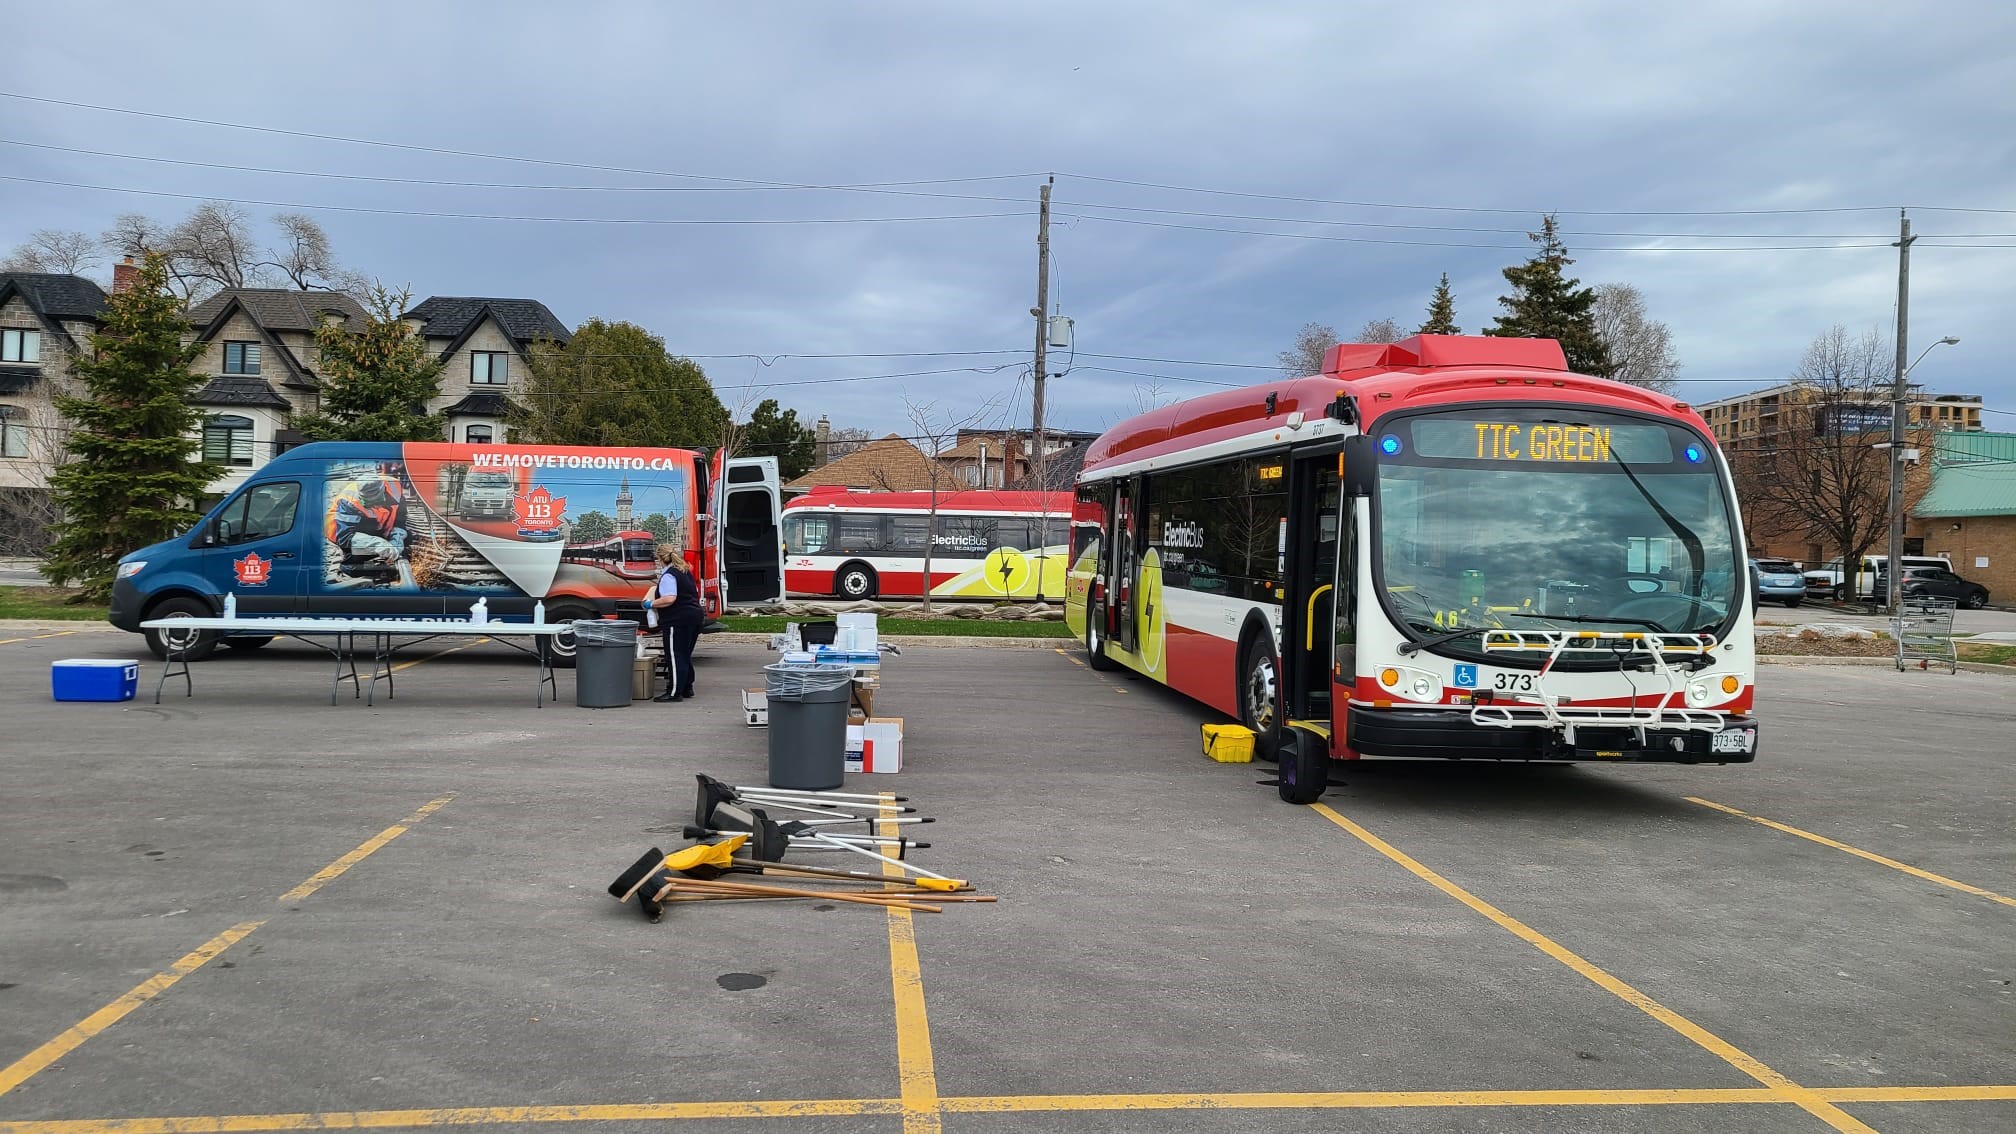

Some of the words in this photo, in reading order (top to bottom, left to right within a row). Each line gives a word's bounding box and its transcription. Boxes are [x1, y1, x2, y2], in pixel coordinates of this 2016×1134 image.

[1474, 424, 1521, 459] TTC
[1529, 425, 1610, 461] GREEN
[472, 453, 674, 471] WEMOVETORONTO.CA
[532, 495, 548, 504] ATU
[527, 504, 551, 518] 113
[1163, 520, 1204, 548] ElectricBus
[244, 565, 261, 575] 113
[1494, 673, 1539, 691] 373
